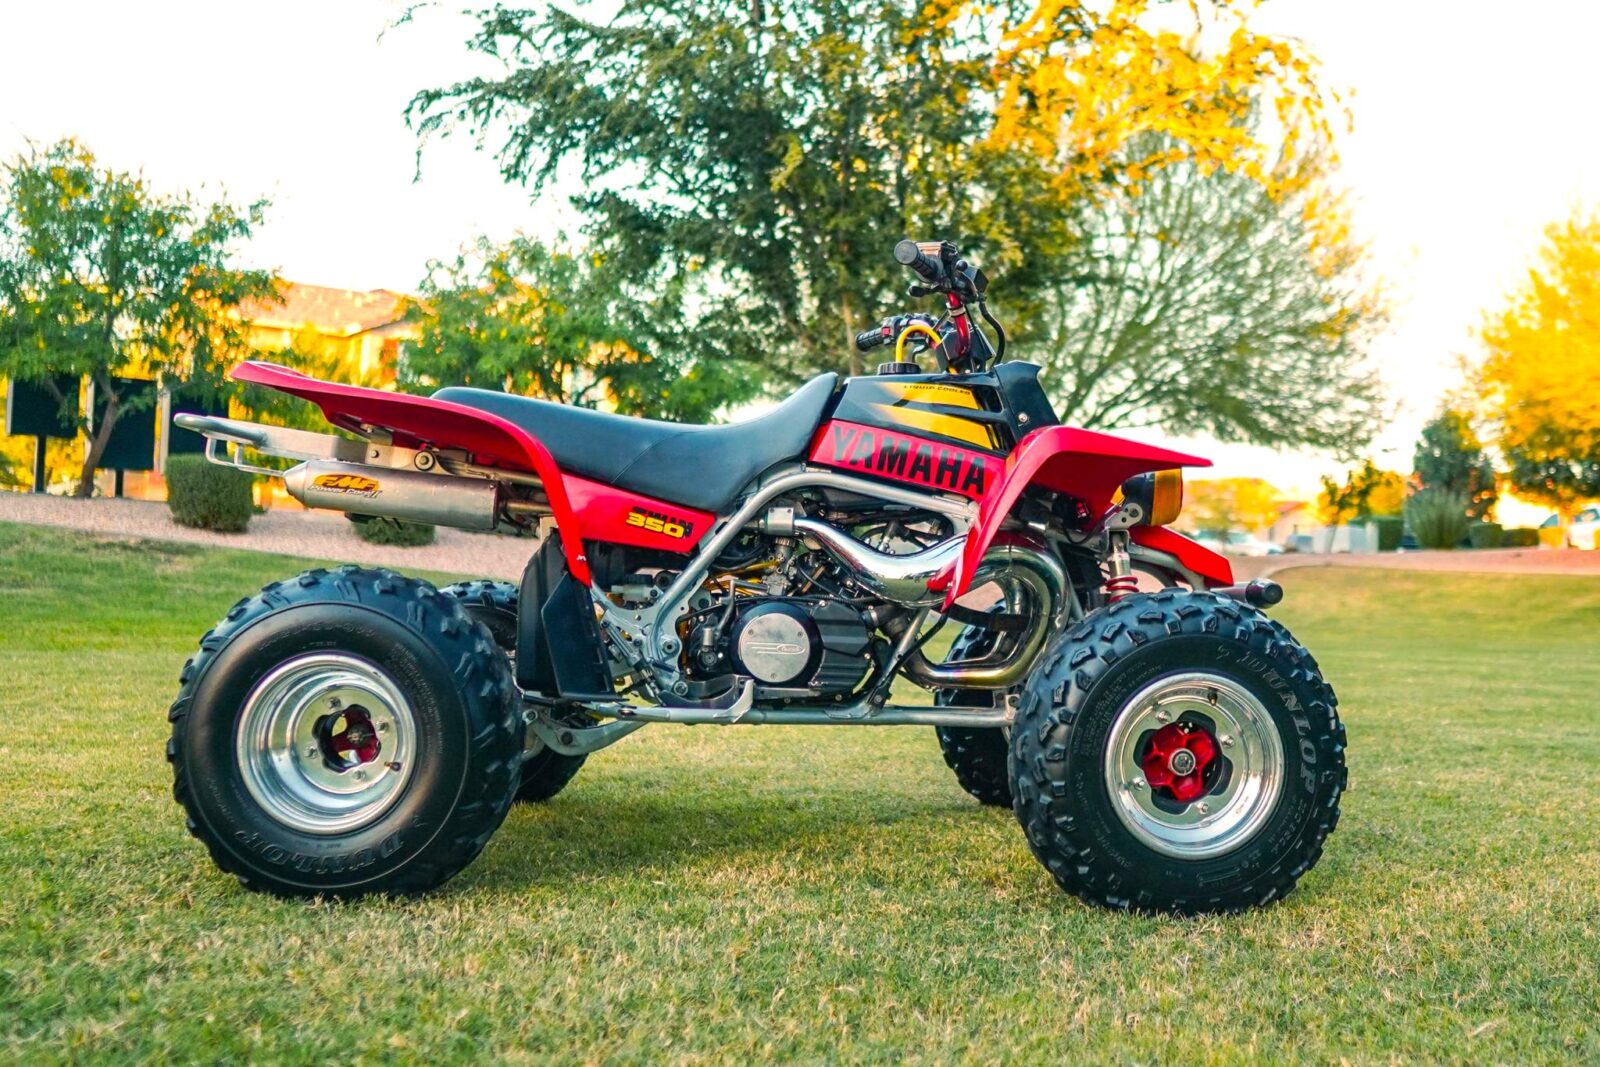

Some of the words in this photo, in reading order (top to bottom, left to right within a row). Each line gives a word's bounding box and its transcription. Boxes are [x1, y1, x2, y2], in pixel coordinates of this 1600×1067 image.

[314, 474, 379, 491] FMF
[833, 426, 985, 495] YAMAHA
[625, 512, 684, 538] 350
[1236, 651, 1317, 794] DUNLOP
[234, 830, 404, 874] DUNLOP
